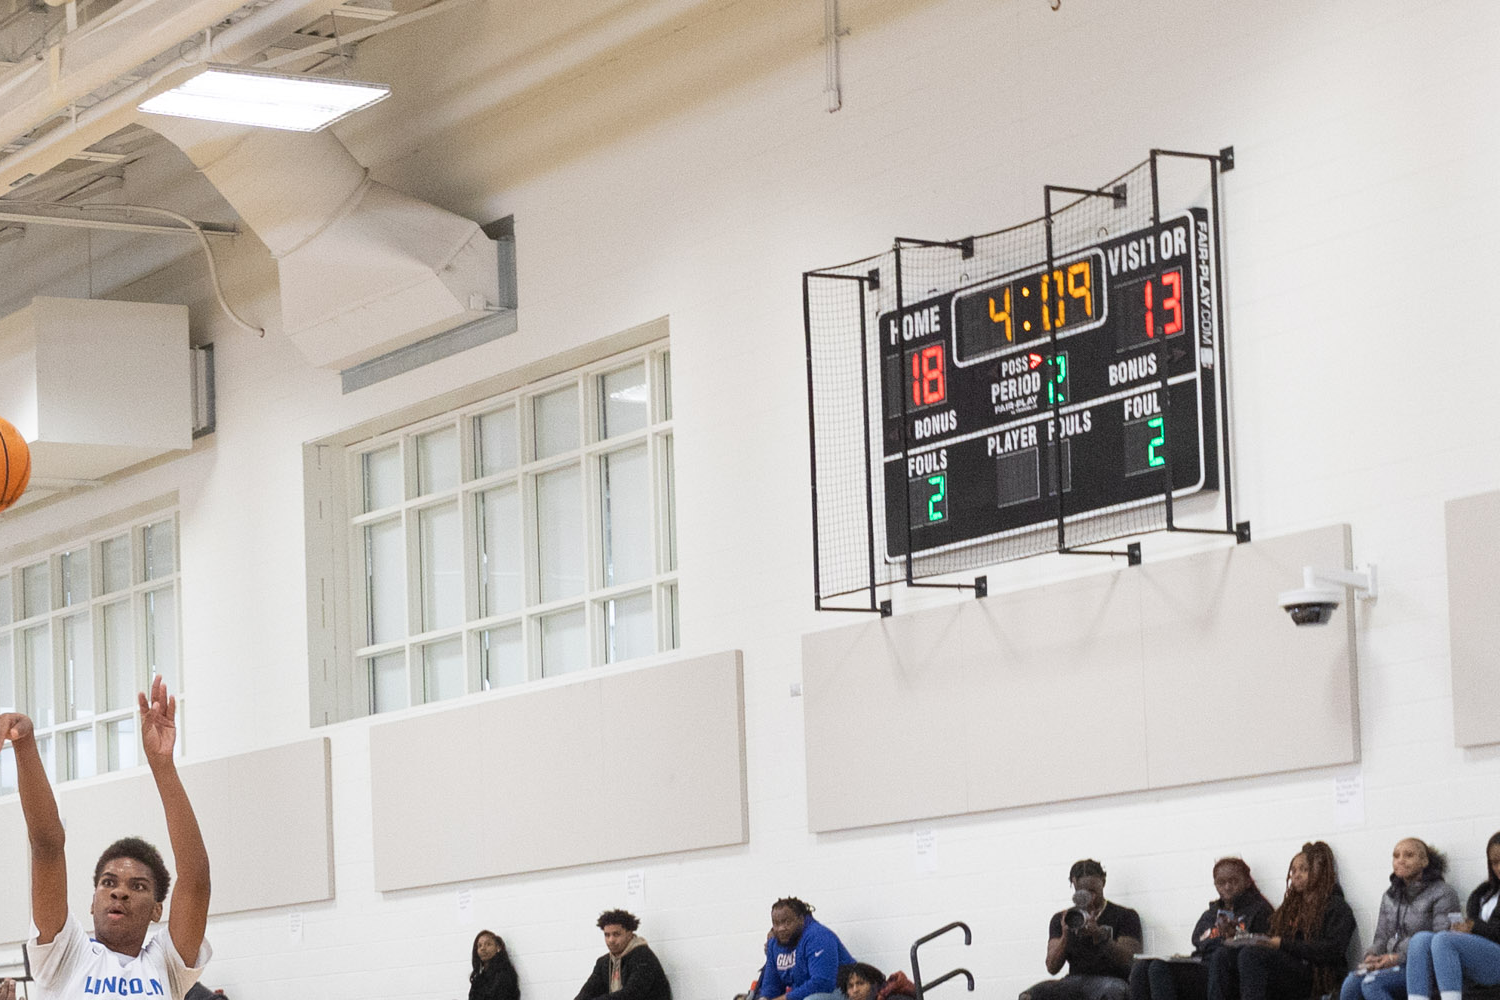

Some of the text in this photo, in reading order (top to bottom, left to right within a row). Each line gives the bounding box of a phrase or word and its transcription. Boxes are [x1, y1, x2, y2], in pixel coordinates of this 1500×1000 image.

[1107, 226, 1187, 276] VISITOR
[989, 261, 1092, 342] 4:09
[1144, 271, 1183, 339] 13
[1197, 220, 1212, 345] FAIR-PLAY.COM
[890, 305, 941, 345] HOME
[912, 345, 945, 406] 18
[991, 371, 1041, 404] PERIOD
[1001, 355, 1029, 378] POSS
[1108, 352, 1158, 387] BONUS
[915, 409, 957, 440] BONUS
[1124, 391, 1162, 421] FOUL
[987, 410, 1092, 457] PLAYER FOULS
[1148, 417, 1165, 467] 2
[908, 449, 947, 478] FOULS
[928, 475, 945, 521] 2
